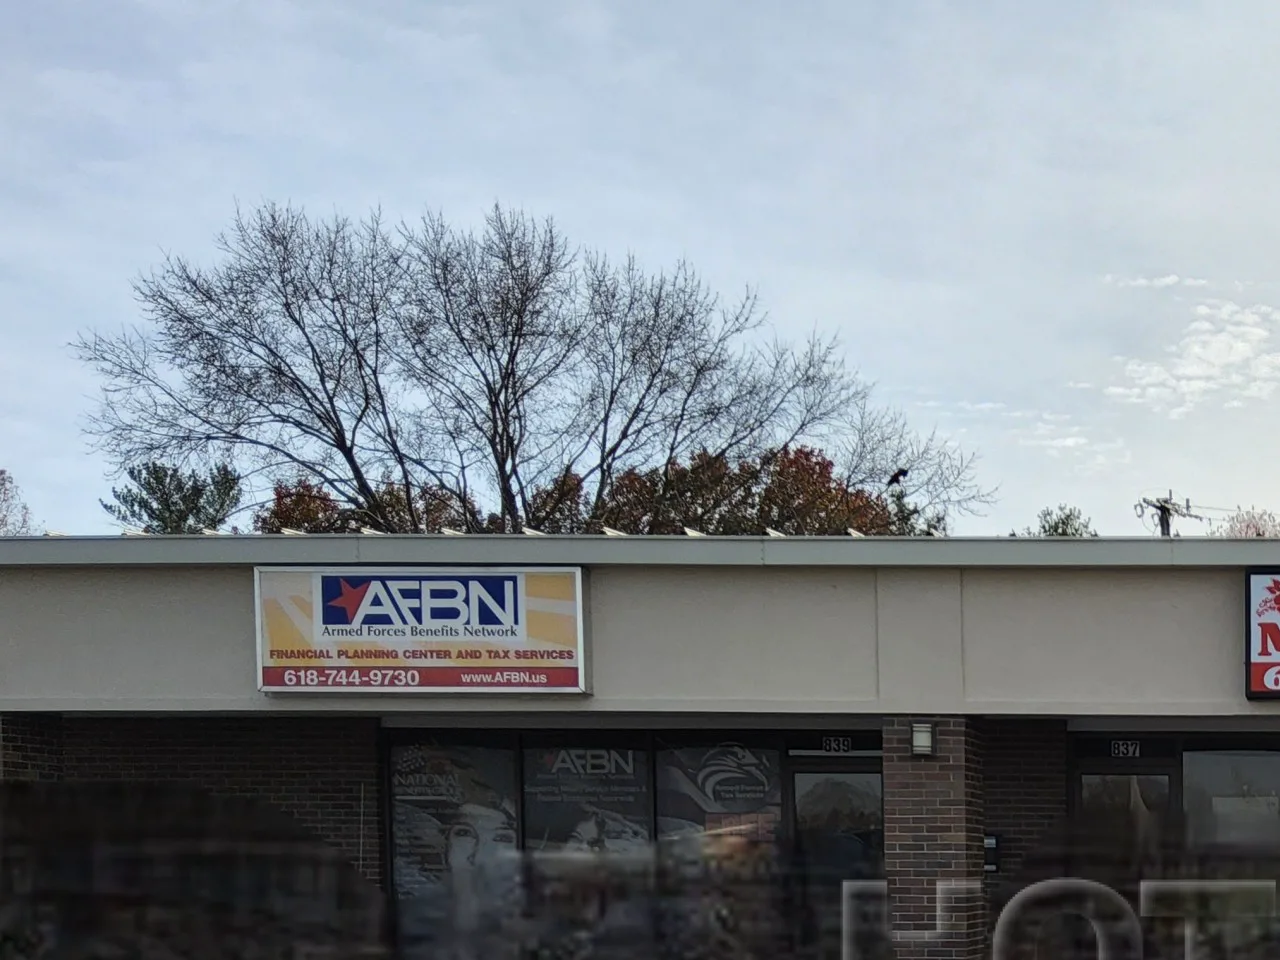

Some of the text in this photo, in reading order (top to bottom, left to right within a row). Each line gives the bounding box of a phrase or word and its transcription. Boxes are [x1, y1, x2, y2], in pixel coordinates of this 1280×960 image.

[352, 580, 515, 626] AFBN
[322, 625, 518, 637] Armed Forces Benefits Network
[269, 649, 574, 660] FINANCIAL PLANNING CENTER AND TAX SERVICES
[284, 670, 420, 686] 618-744-9730
[461, 672, 547, 684] www.AFBN.us
[824, 738, 850, 752] 839
[1113, 742, 1138, 756] 837
[551, 750, 635, 774] AFBN
